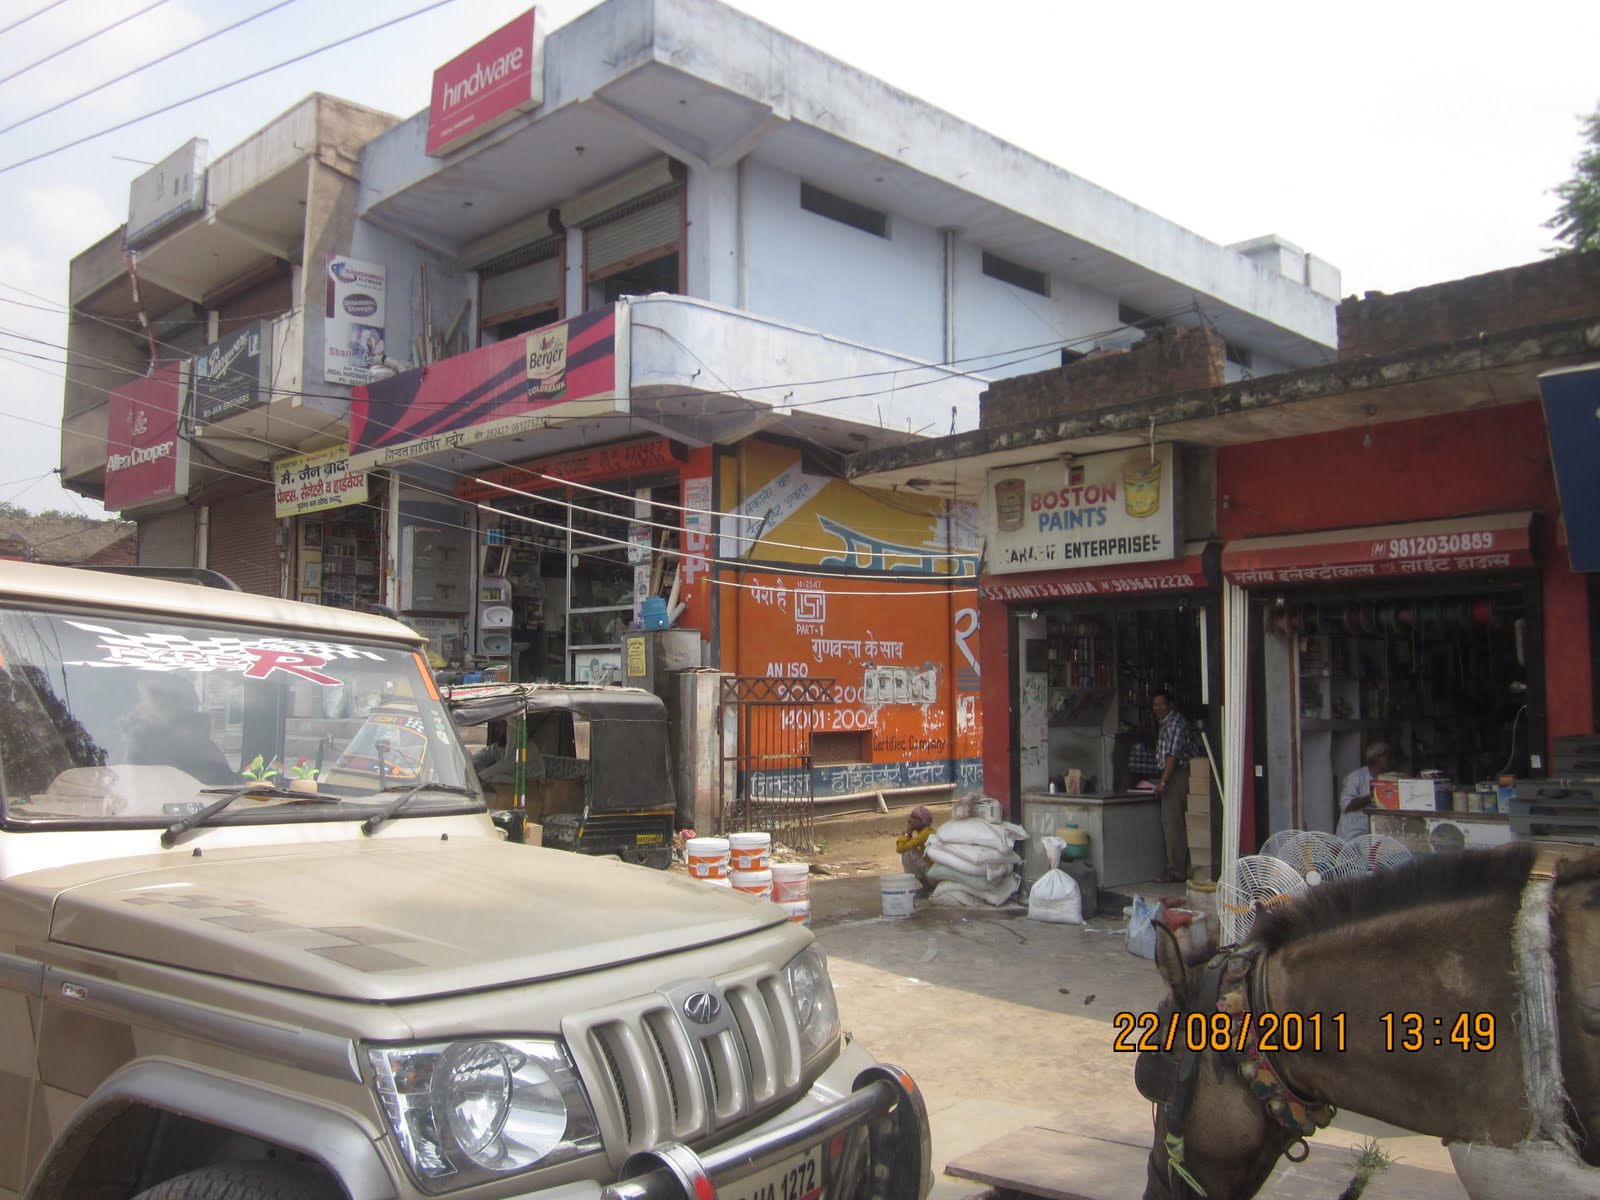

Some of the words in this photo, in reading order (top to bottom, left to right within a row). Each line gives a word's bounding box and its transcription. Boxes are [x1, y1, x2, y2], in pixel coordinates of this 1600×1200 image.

[442, 47, 523, 112] hindware
[529, 348, 563, 369] Berger
[131, 441, 174, 466] Cooper
[1031, 483, 1117, 512] BOSTON
[1039, 507, 1107, 533] PAINTS
[1058, 580, 1098, 595] INDIA
[244, 647, 344, 686] R
[766, 663, 783, 678] AN
[787, 663, 808, 678] ISO
